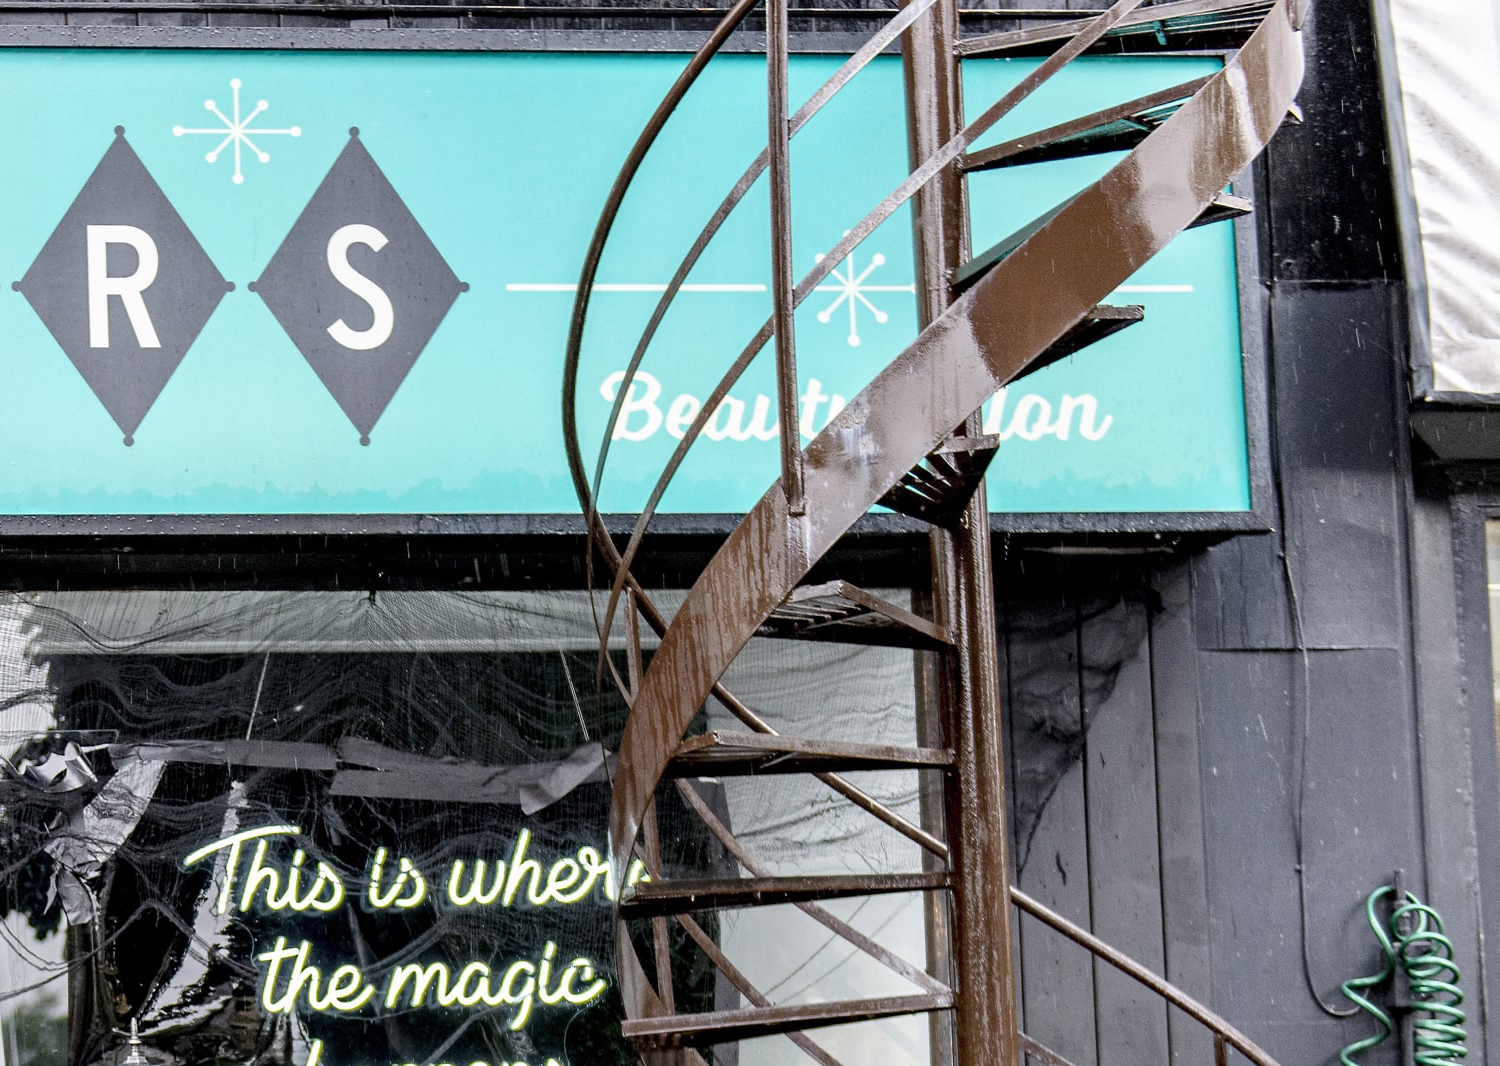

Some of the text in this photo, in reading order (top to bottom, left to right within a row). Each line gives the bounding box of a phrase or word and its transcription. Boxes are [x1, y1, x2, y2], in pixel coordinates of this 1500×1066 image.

[983, 384, 1114, 441] lon
[184, 825, 346, 915] This
[368, 846, 428, 908] is
[258, 936, 606, 1032] the magic
